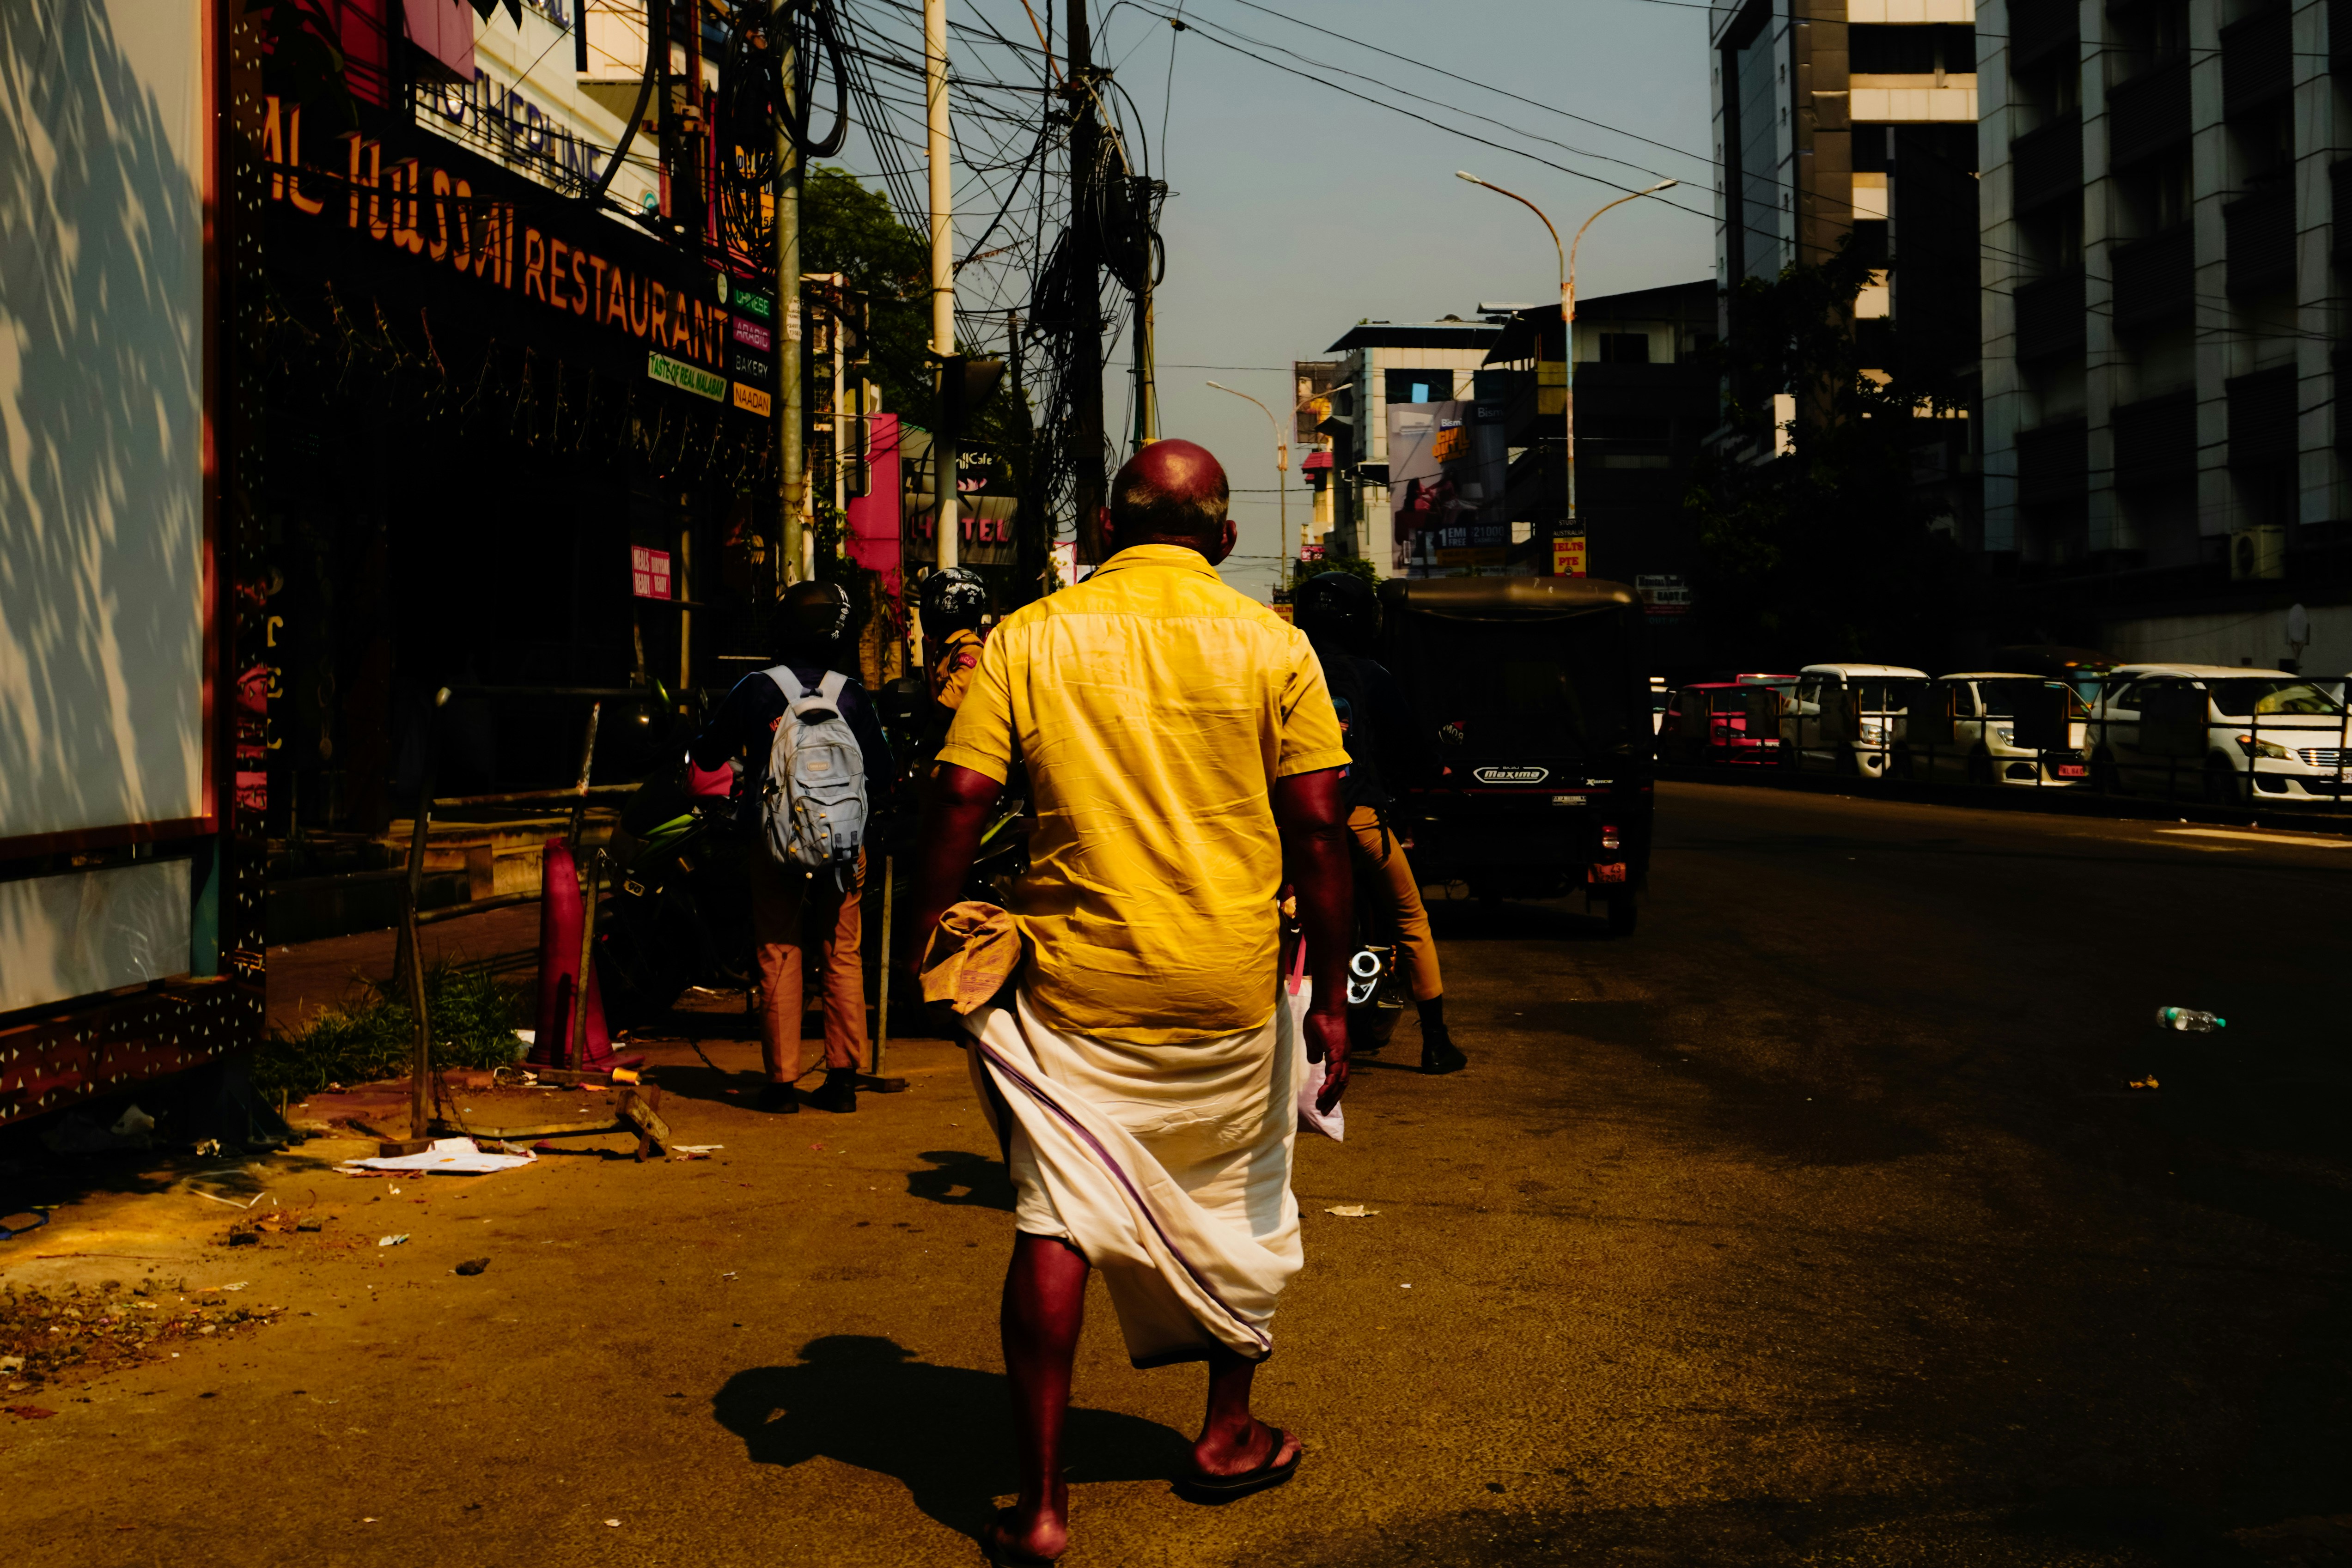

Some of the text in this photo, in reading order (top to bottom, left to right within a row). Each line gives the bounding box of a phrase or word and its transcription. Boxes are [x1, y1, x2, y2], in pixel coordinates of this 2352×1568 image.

[524, 225, 728, 369] RESTAURANT
[736, 289, 769, 316] CHINESE
[736, 322, 768, 348] ARABIC
[651, 355, 724, 398] TASTE OF REAL MALABAR
[736, 354, 768, 379] BAKERY
[735, 386, 769, 412] NAADAN
[1441, 418, 1463, 427] Bismi
[911, 516, 1010, 542] HTEL
[1448, 528, 1466, 537] EMI
[1553, 542, 1584, 552] IELTS
[634, 548, 649, 572] MEALS
[1559, 557, 1578, 565] PTE
[634, 572, 651, 595] READY
[654, 575, 667, 593] READY
[1657, 591, 1680, 600] EAST
